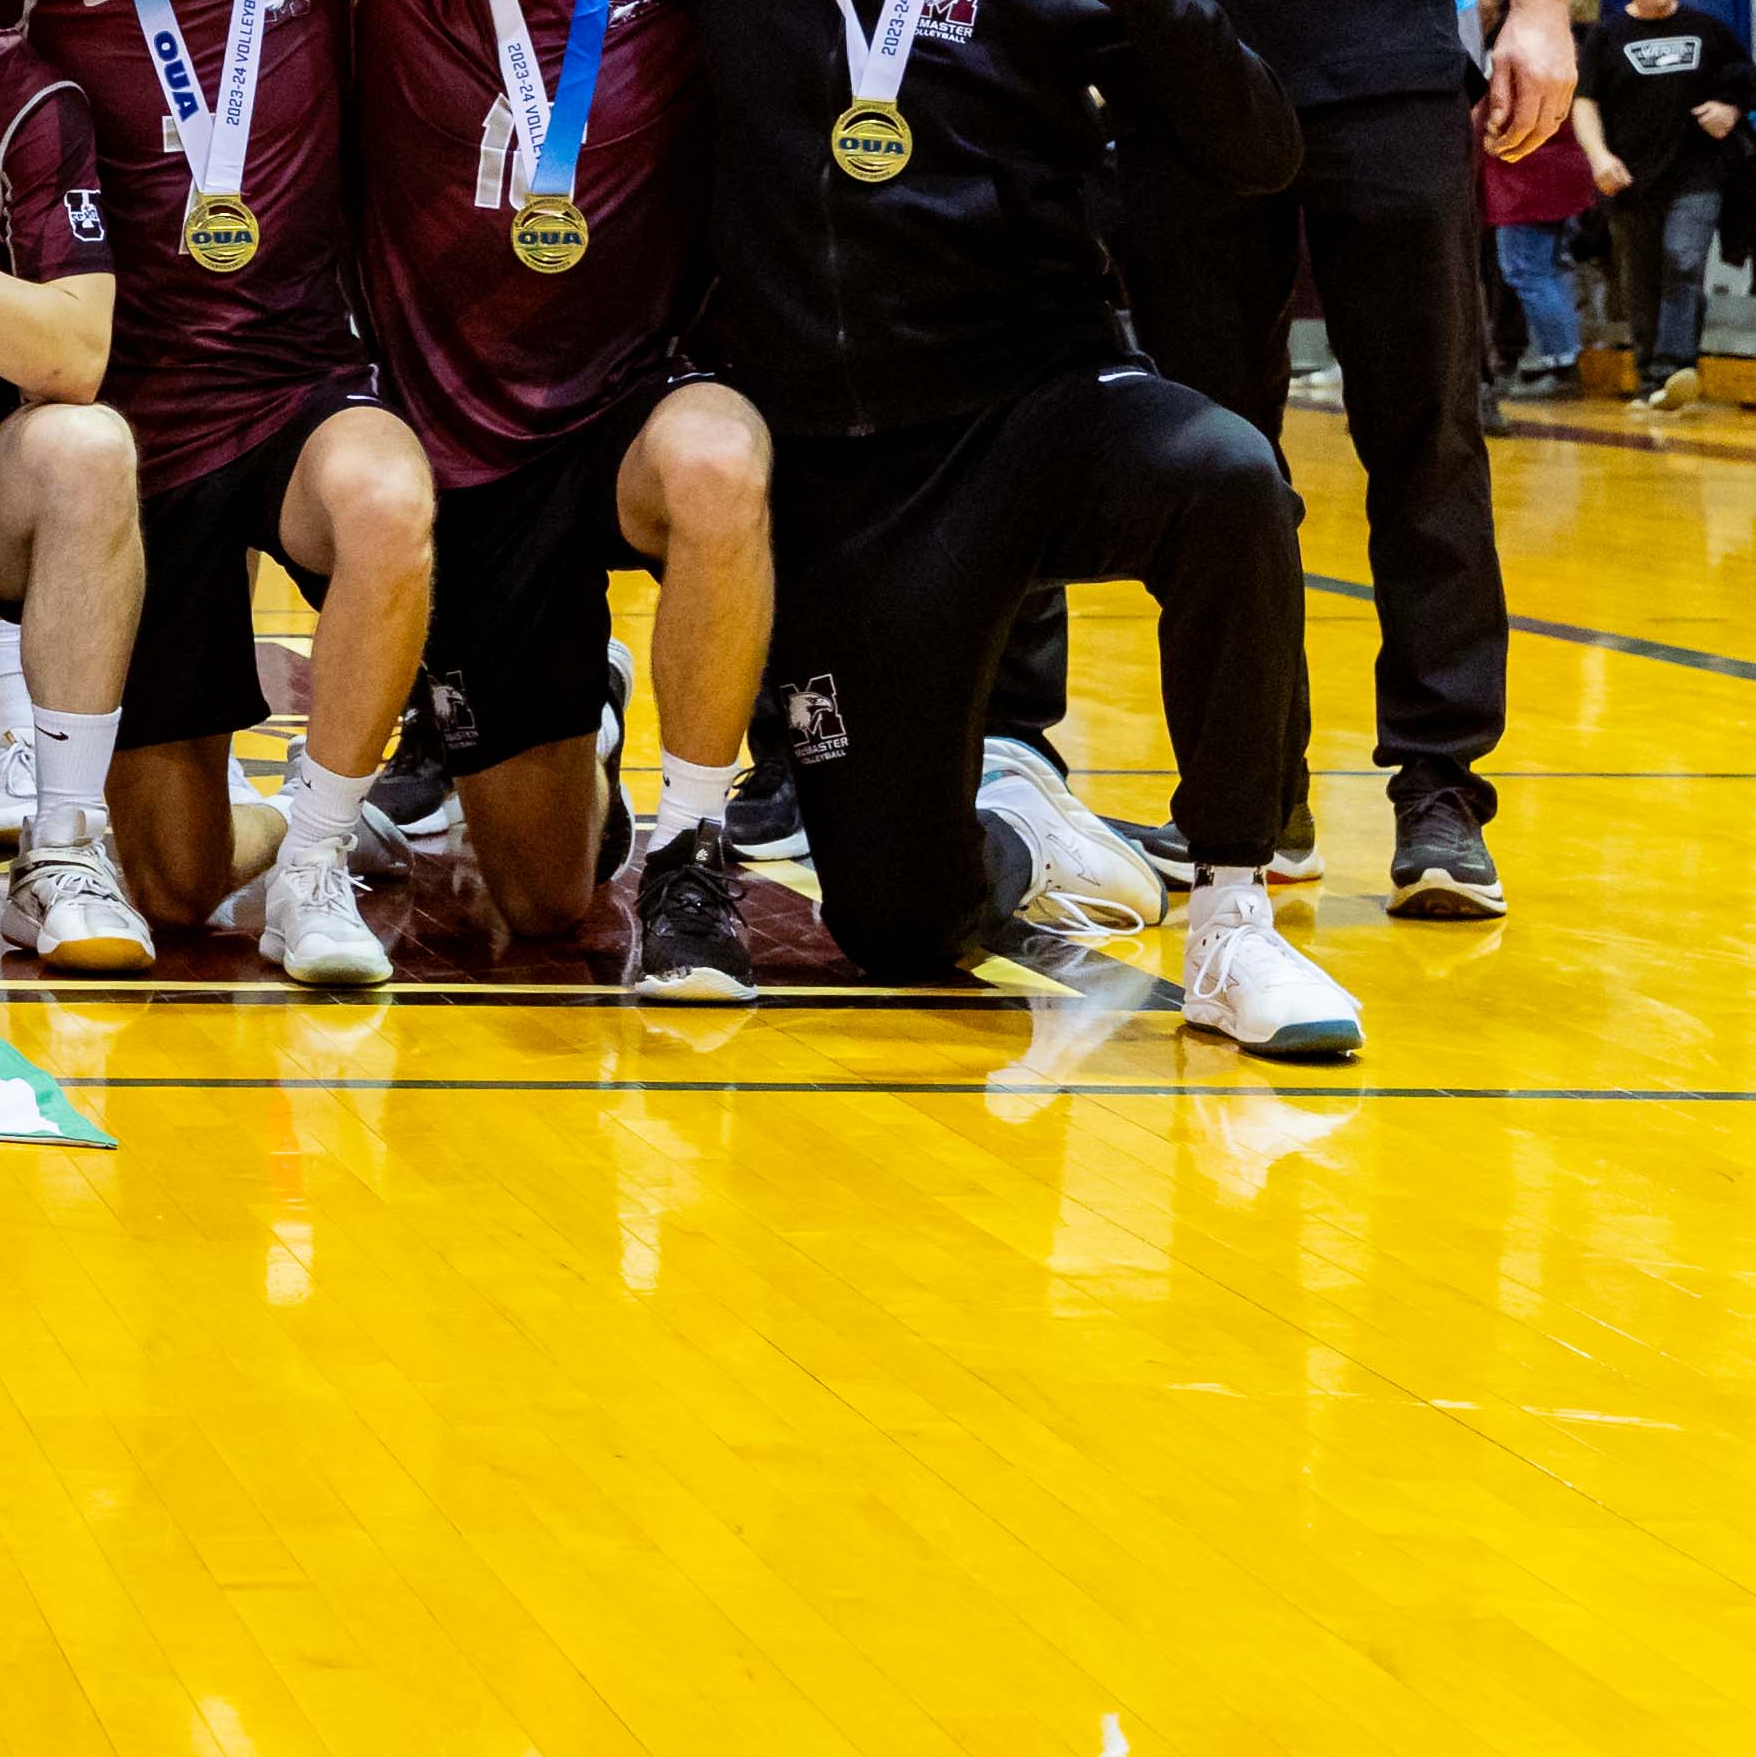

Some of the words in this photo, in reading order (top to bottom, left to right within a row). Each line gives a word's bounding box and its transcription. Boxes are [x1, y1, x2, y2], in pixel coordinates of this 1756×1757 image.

[913, 18, 974, 38] MASTER
[152, 29, 199, 123] OUA
[507, 42, 535, 106] 2023-24
[226, 63, 250, 127] 2023-24
[838, 134, 906, 156] OUA
[189, 229, 253, 246] OUA
[516, 229, 584, 247] OUA
